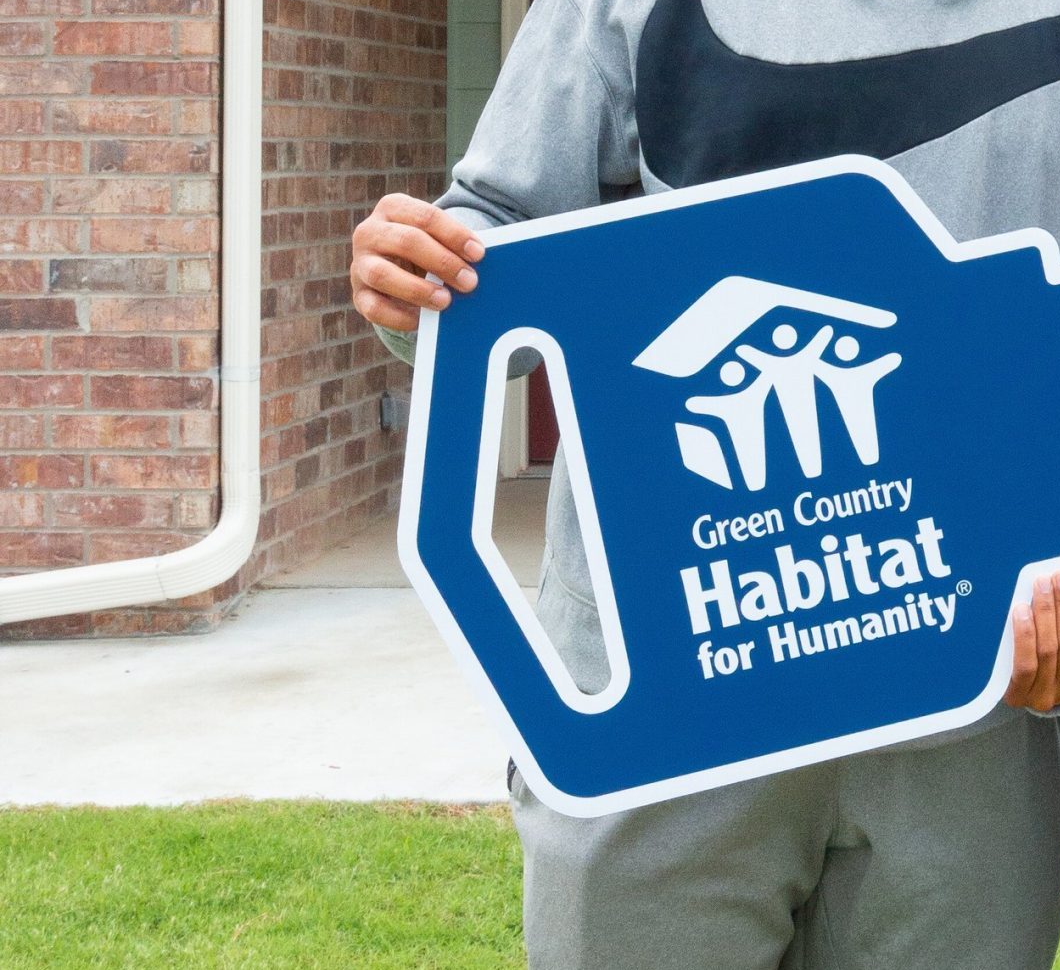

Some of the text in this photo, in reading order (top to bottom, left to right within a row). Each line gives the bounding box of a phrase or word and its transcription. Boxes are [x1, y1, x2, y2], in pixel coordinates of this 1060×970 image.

[692, 478, 913, 550] Green Country
[679, 516, 952, 635] Habitat
[696, 640, 756, 680] for
